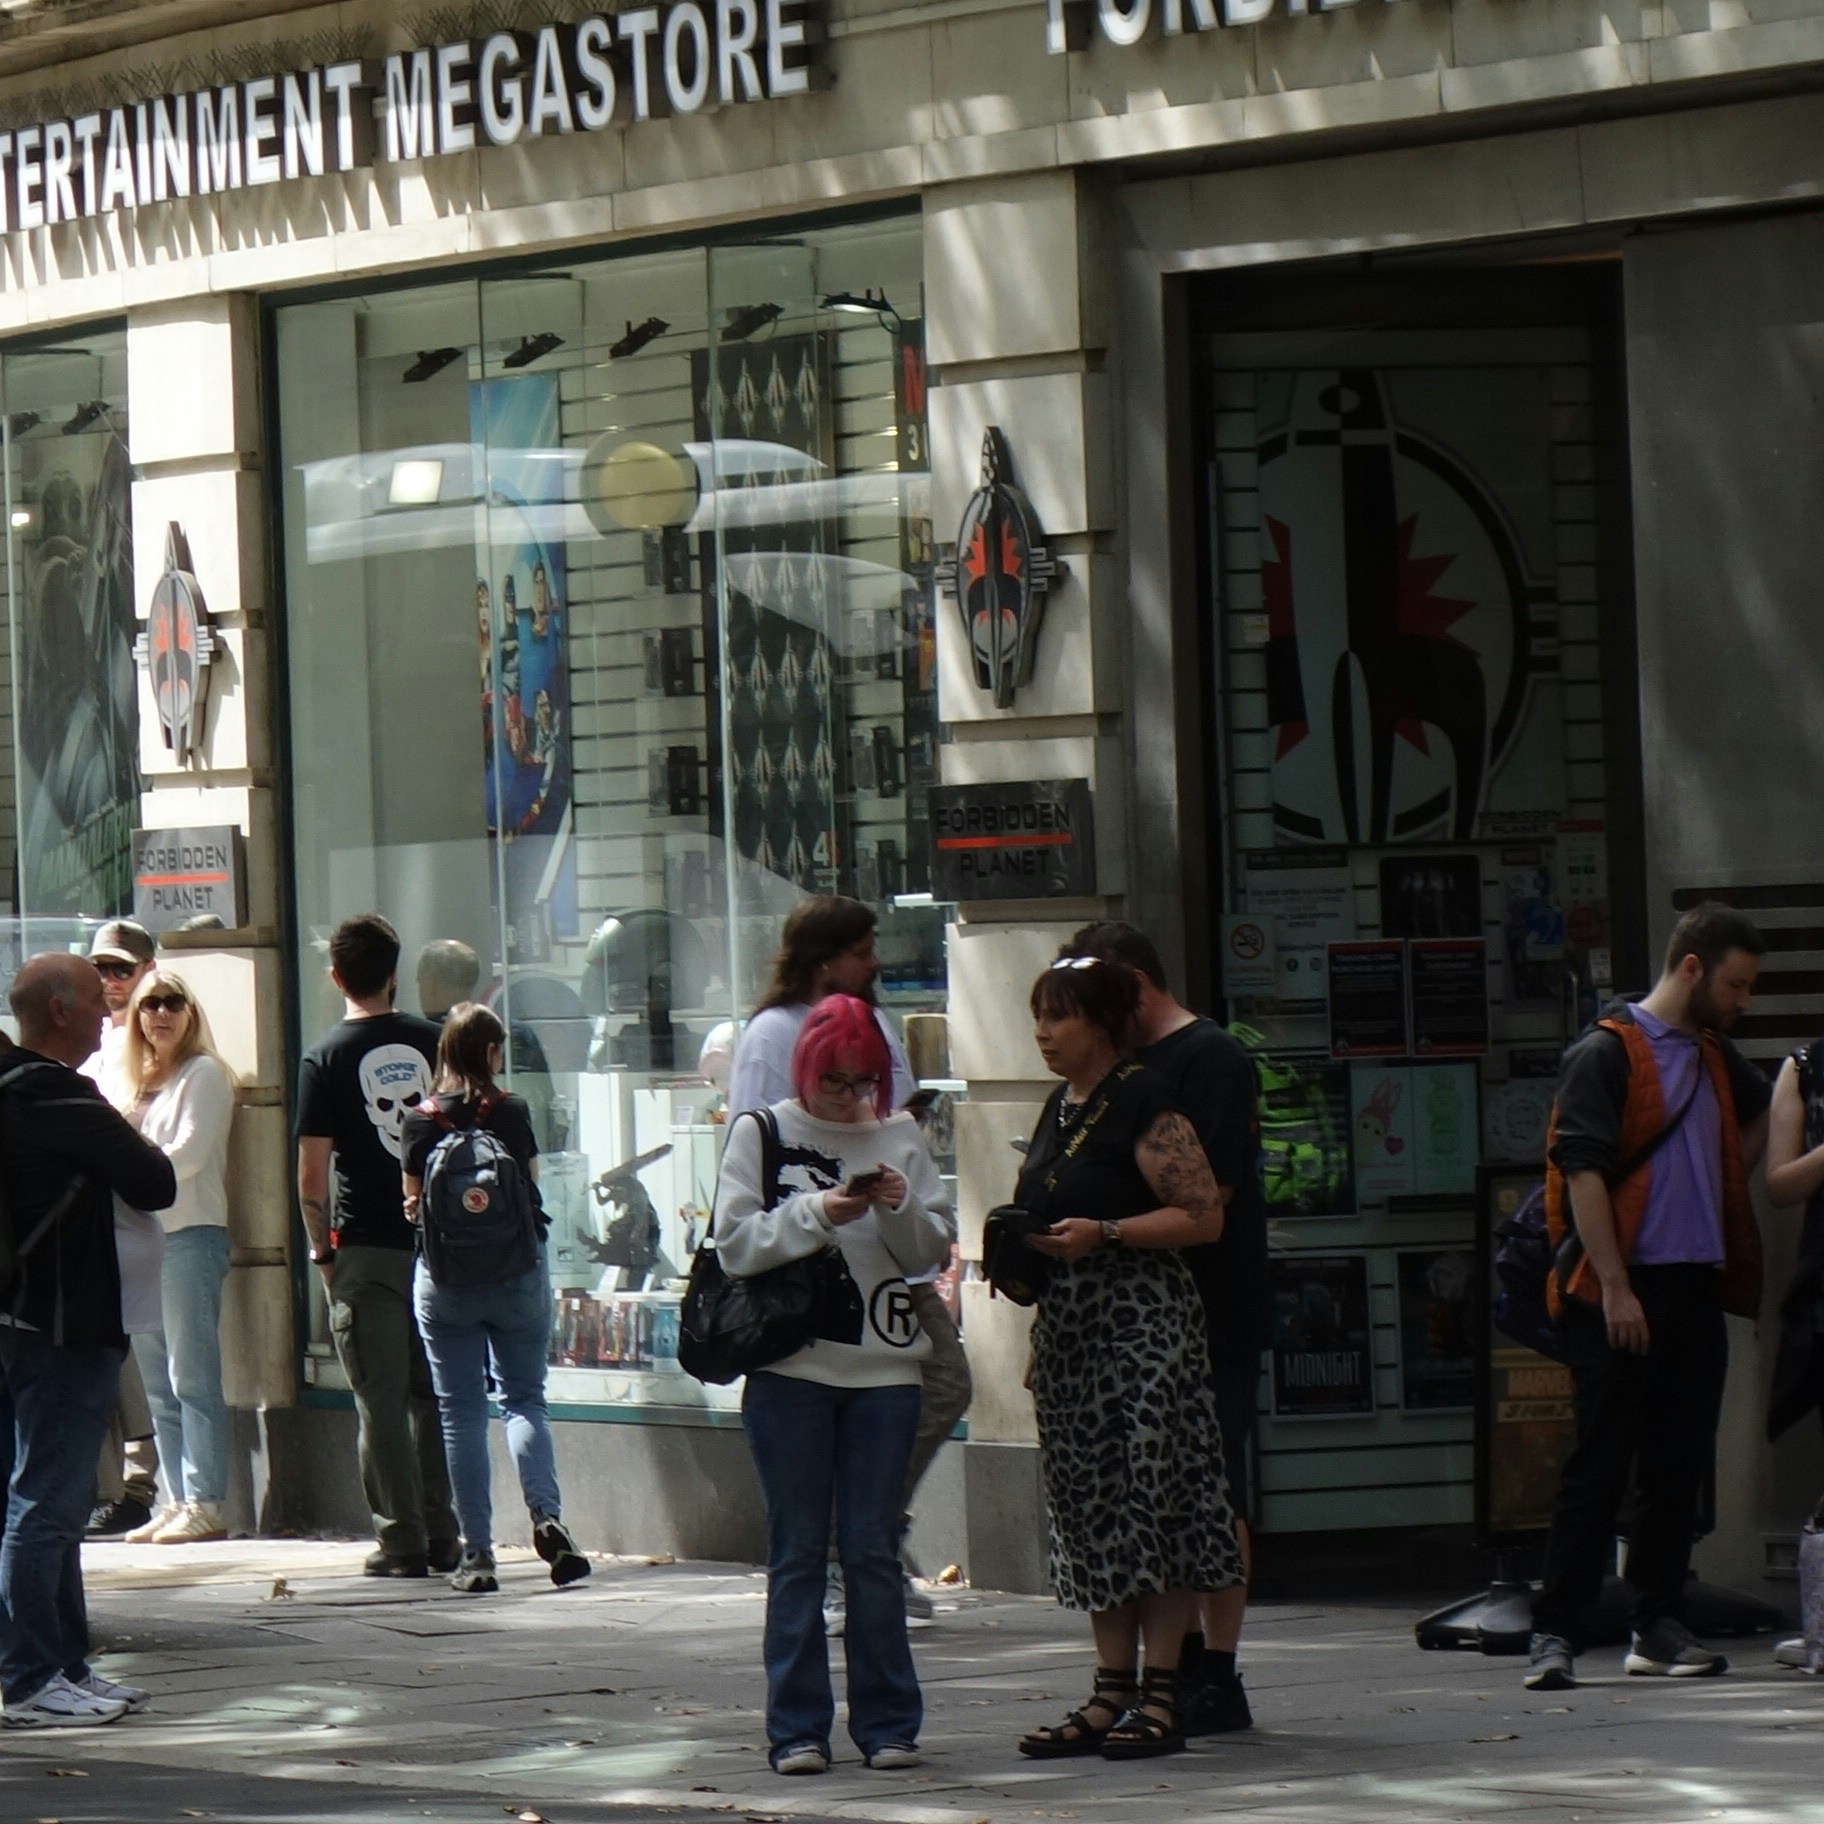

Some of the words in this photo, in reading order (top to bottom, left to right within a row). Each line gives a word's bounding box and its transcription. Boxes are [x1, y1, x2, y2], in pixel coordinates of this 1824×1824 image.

[936, 802, 1072, 833] FORBIDDEN
[138, 844, 228, 871] FORBIDDEN
[961, 849, 1051, 878] PLANET
[153, 885, 214, 911] PLANET
[374, 1062, 417, 1077] STONE
[1281, 1350, 1363, 1389] MIDNIGHT
